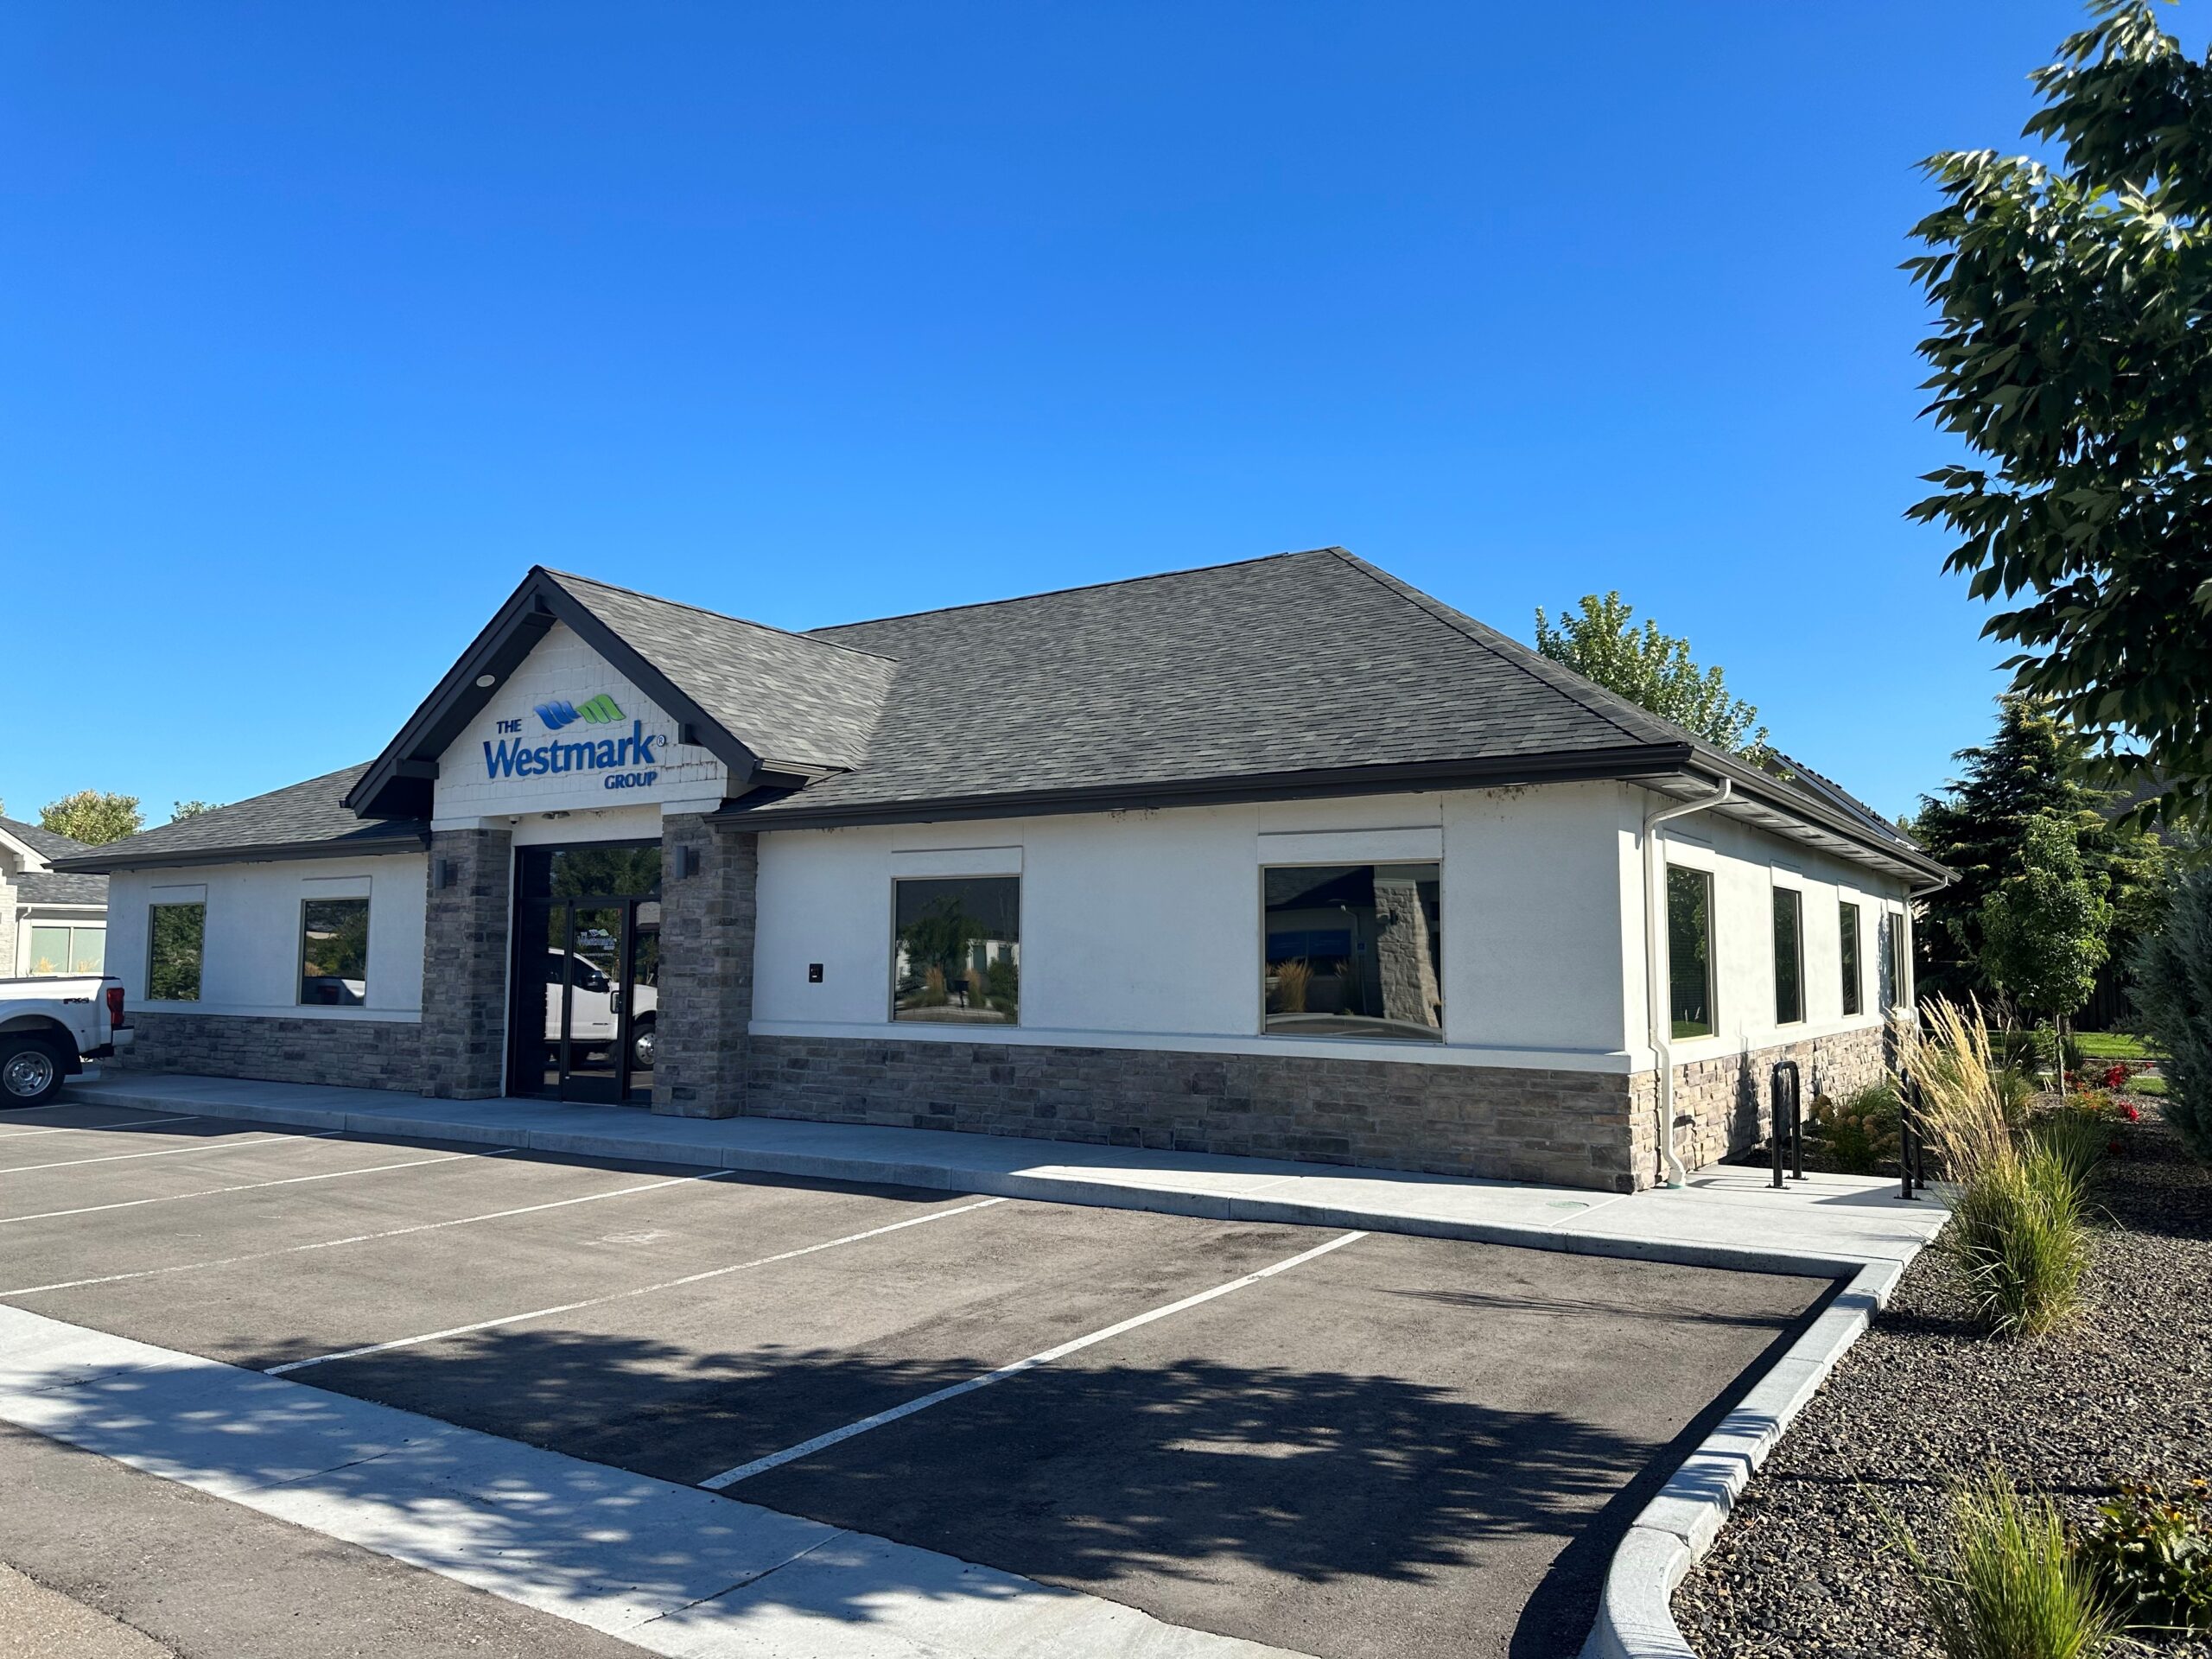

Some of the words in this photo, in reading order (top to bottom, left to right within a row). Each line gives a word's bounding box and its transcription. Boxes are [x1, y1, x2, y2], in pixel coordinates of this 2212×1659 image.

[496, 719, 522, 734] THE
[483, 720, 657, 779] Westmark
[604, 771, 658, 790] GROUP
